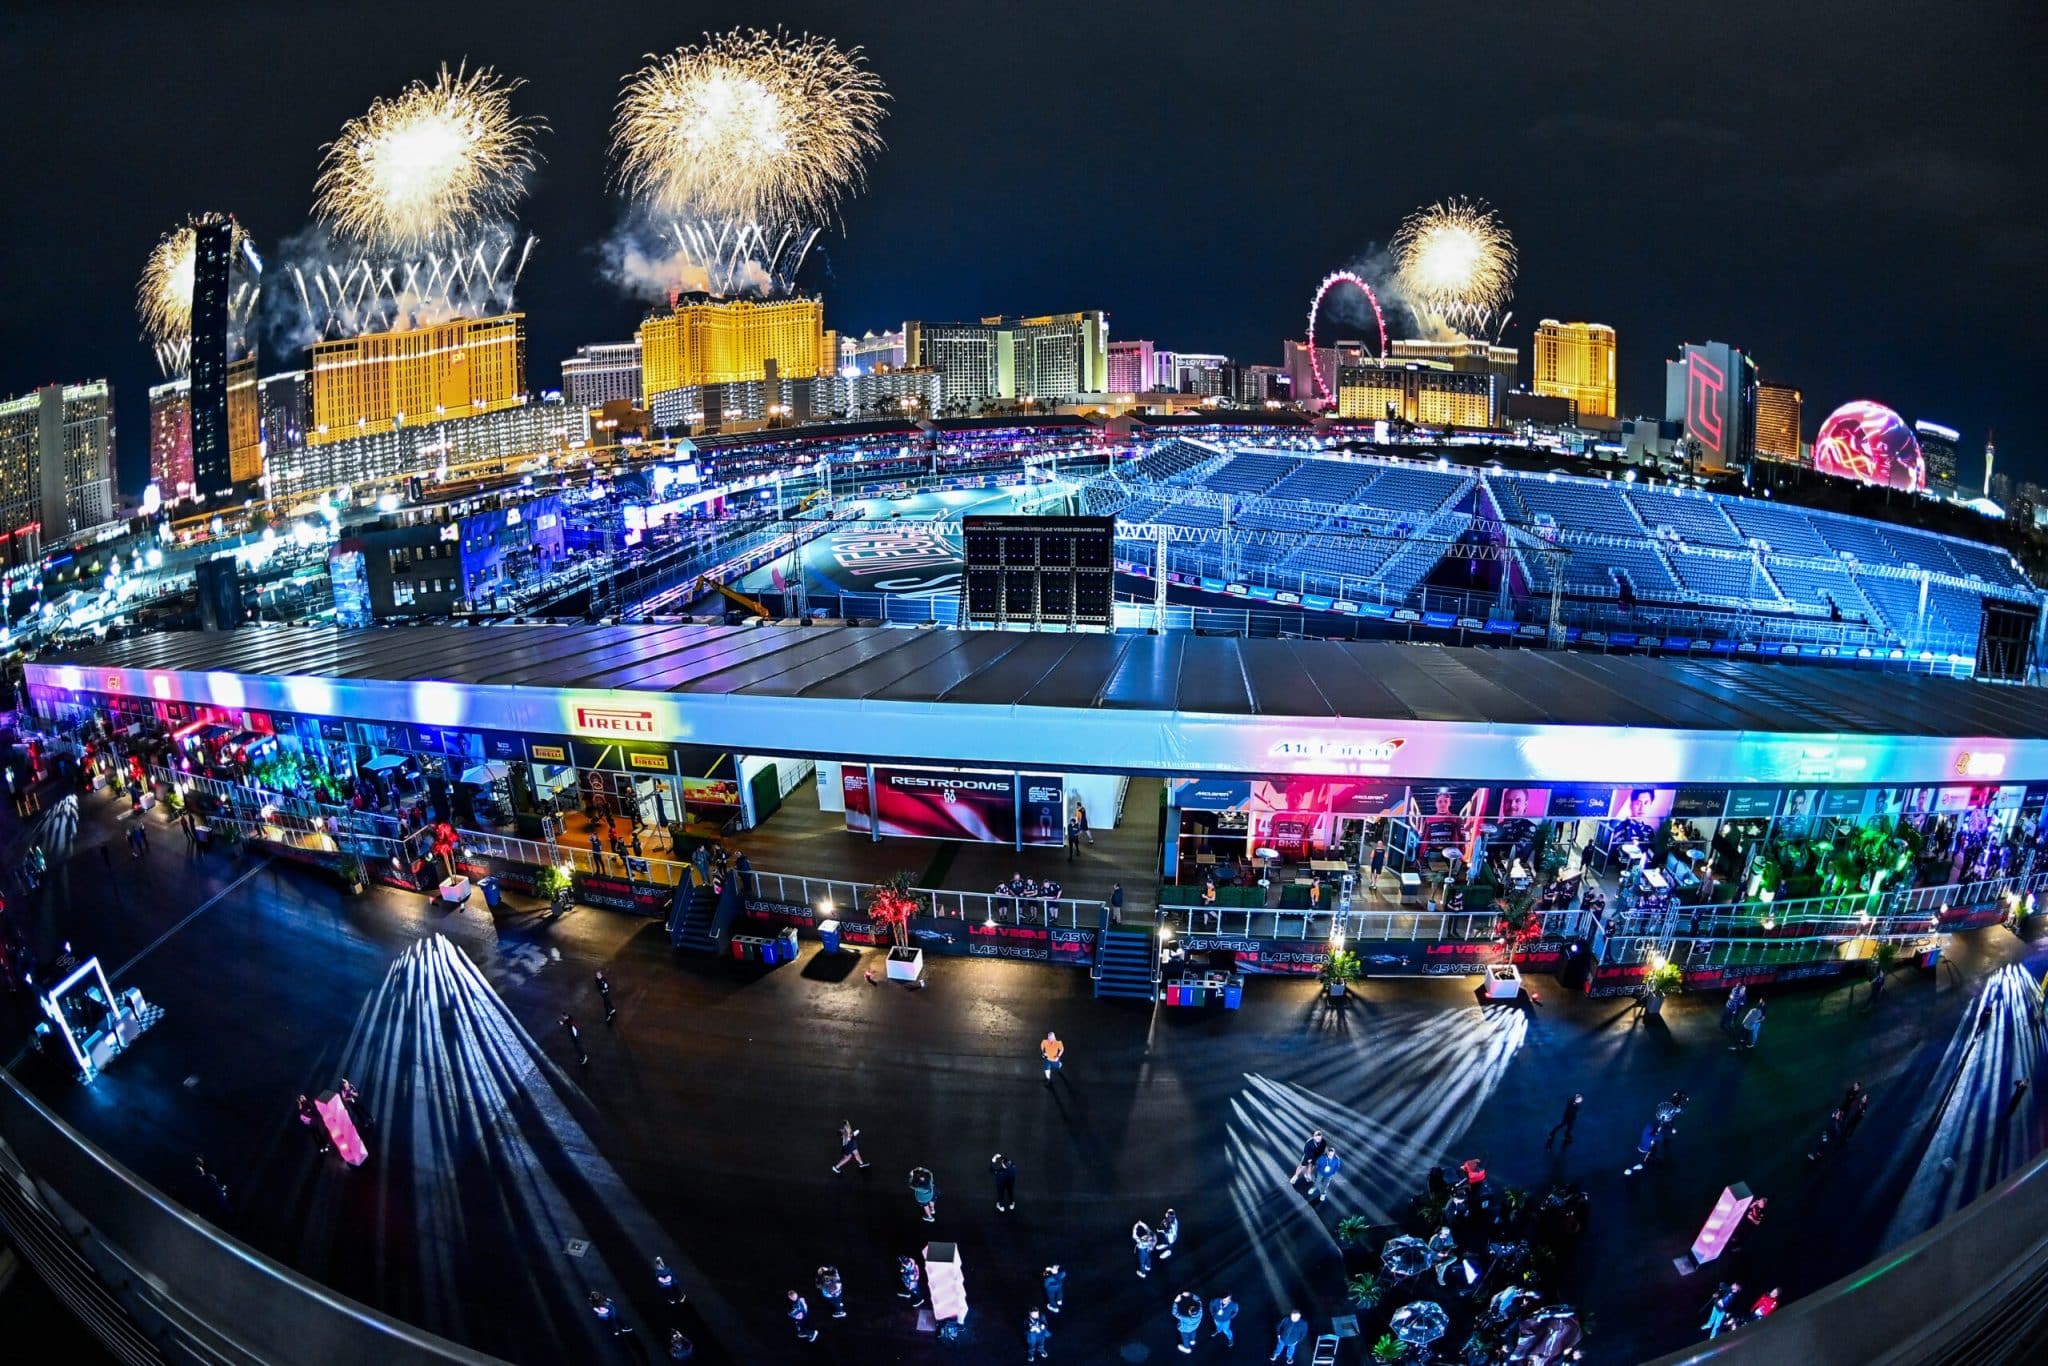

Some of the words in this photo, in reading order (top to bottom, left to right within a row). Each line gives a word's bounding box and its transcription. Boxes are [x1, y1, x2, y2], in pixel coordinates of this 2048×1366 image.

[577, 708, 653, 732] PIRELLI
[535, 748, 562, 758] PIRELLI
[634, 755, 665, 767] PIRELLI
[891, 776, 1010, 791] RESTROOMS
[745, 900, 769, 911] LAS
[770, 903, 813, 918] VEGAS
[842, 921, 889, 935] VEGAS
[968, 925, 997, 936] LAS
[998, 928, 1047, 940] VEGAS
[1051, 931, 1080, 942] LAS
[969, 943, 998, 955] LAS
[999, 946, 1048, 960] VEGAS
[1051, 942, 1080, 952] LAS
[1178, 939, 1208, 950] LAS
[1209, 941, 1260, 952] VEGAS
[1427, 944, 1453, 954] LAS
[1261, 952, 1290, 962] LAS
[1291, 954, 1330, 964] VEGA
[1422, 964, 1450, 973] LAS
[1450, 964, 1488, 973] VEGA
